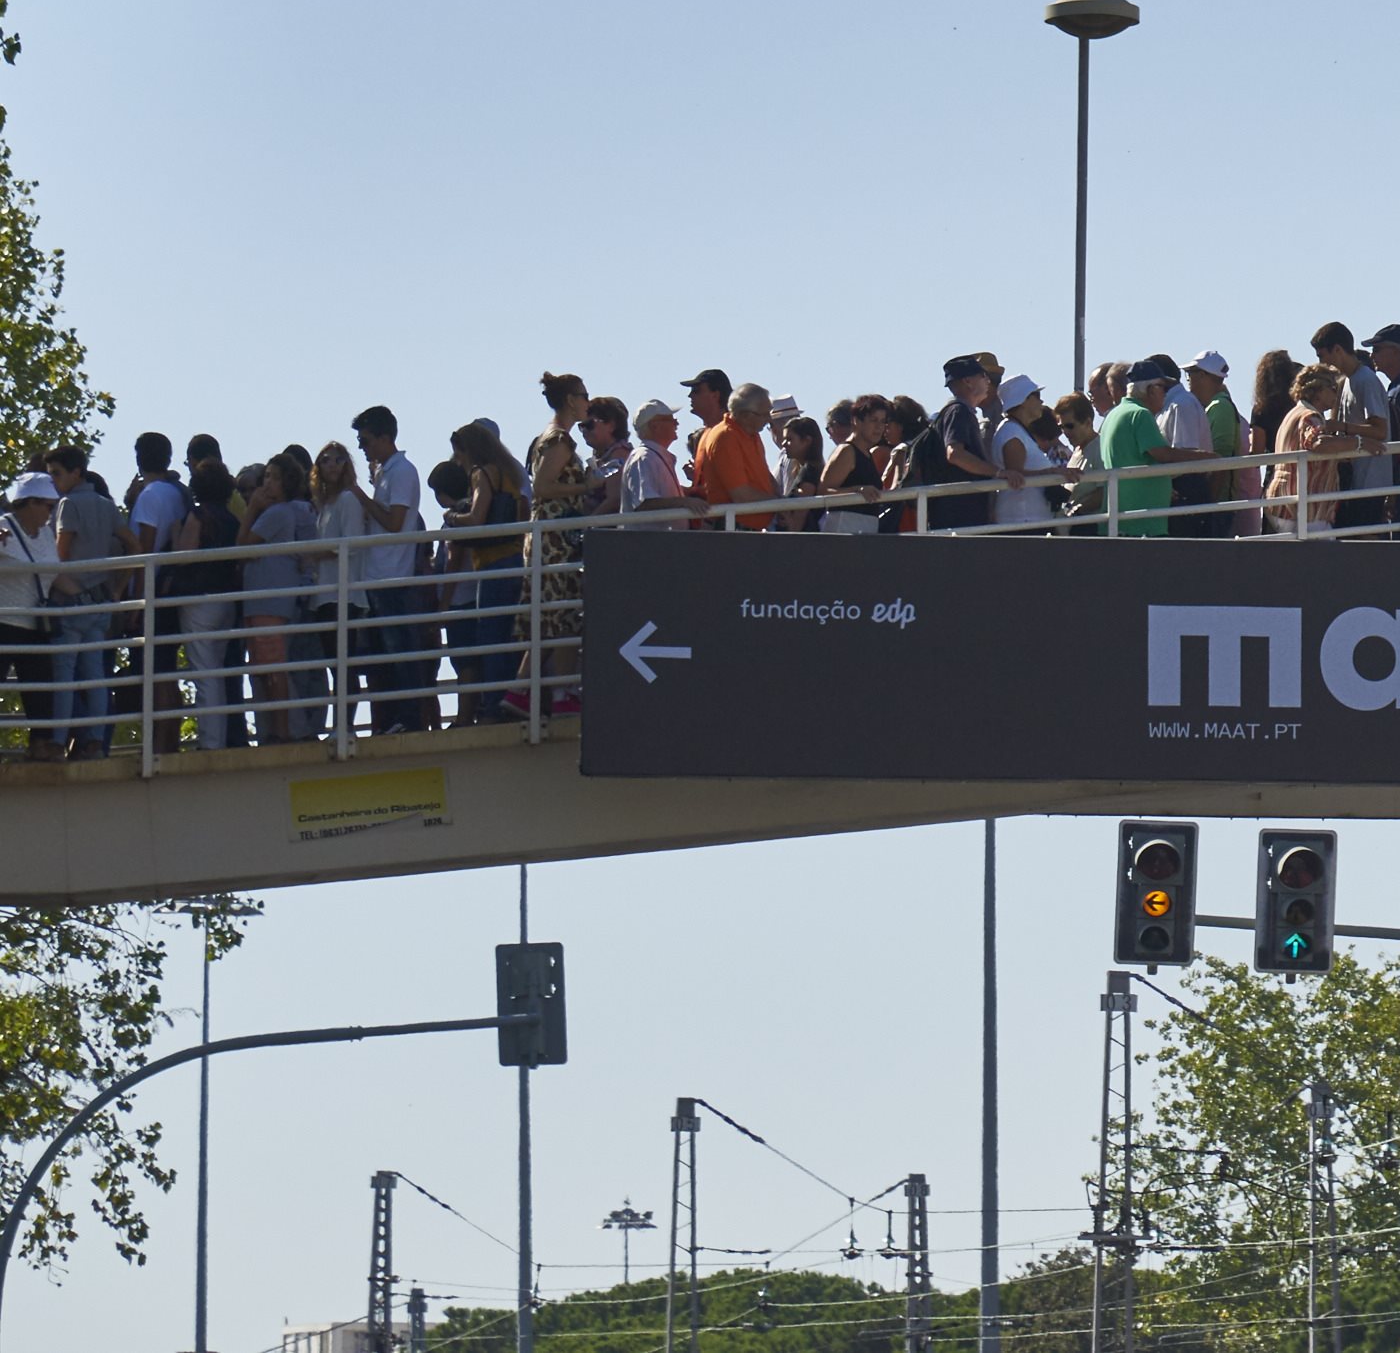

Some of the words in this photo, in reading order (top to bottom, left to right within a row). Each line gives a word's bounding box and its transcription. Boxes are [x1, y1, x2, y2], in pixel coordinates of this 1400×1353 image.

[740, 599, 861, 624] fundação
[871, 598, 916, 629] edp
[1148, 722, 1302, 740] WWW.MAAT.PT
[390, 801, 441, 814] Ribatejo
